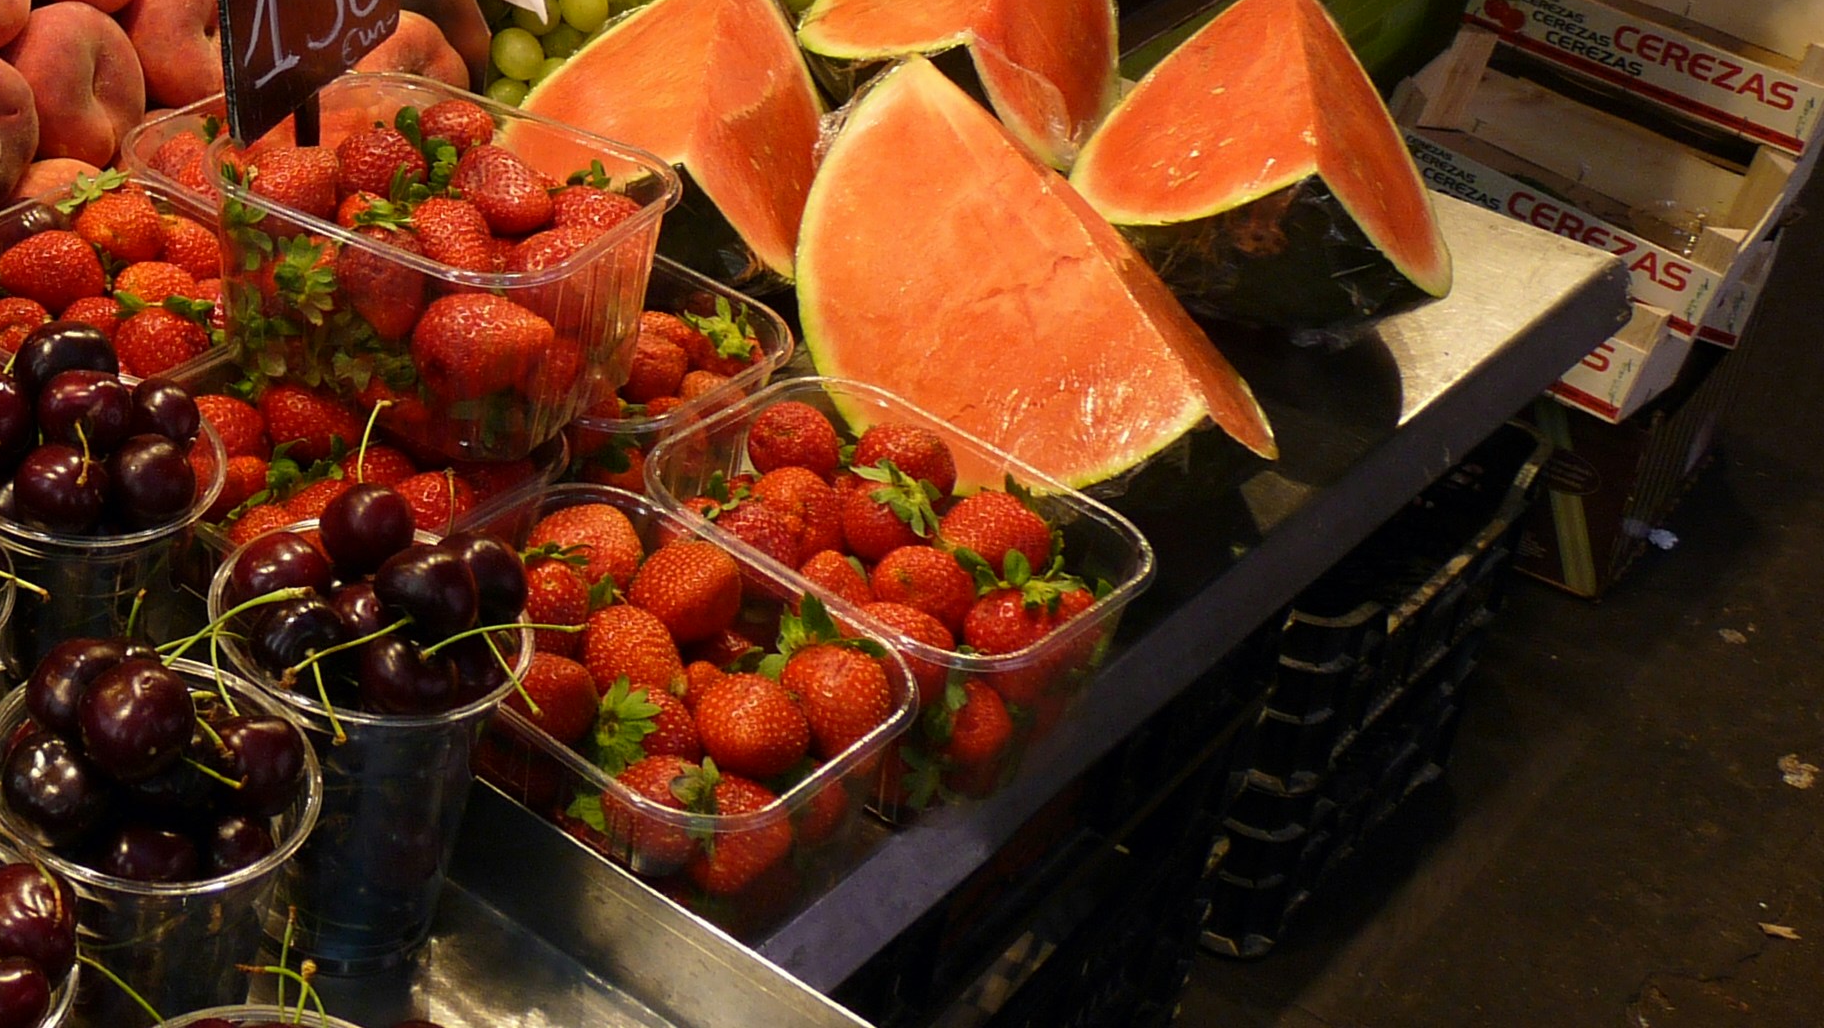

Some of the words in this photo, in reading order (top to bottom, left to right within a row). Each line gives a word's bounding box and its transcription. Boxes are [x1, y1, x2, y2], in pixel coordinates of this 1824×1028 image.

[1532, 9, 1612, 48] CEREZAS
[1545, 29, 1644, 78] CEREZAS
[1613, 24, 1800, 112] CEREZAS
[1406, 135, 1453, 161] CEREZAS
[1414, 151, 1477, 184] CEREZAS
[1423, 167, 1501, 211] CEREZAS
